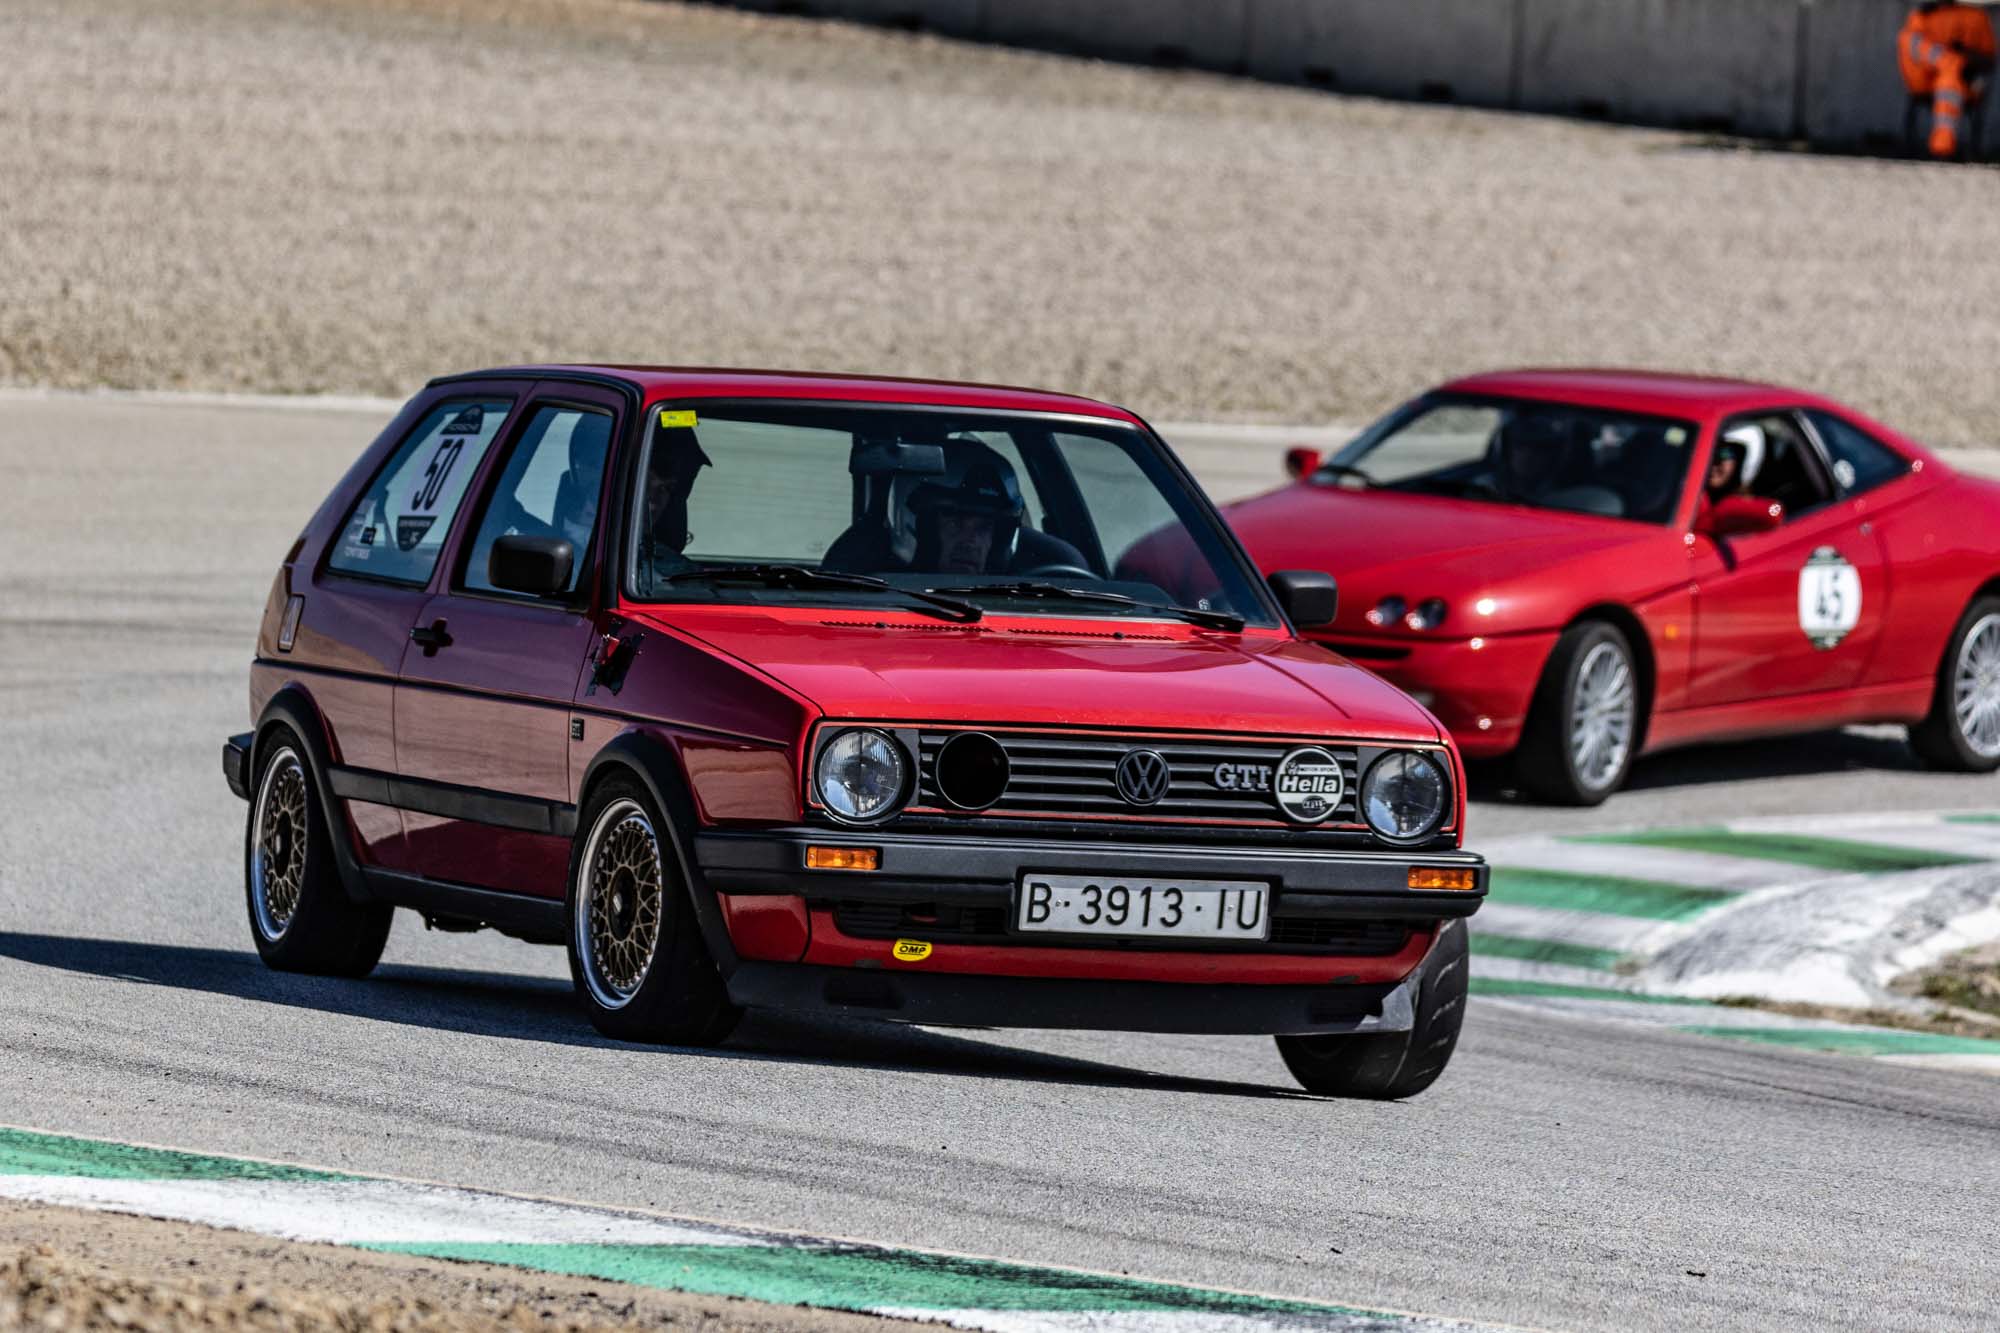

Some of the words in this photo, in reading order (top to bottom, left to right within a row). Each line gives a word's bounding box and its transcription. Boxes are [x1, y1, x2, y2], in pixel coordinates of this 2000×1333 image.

[411, 438, 465, 511] 50
[1214, 762, 1272, 792] GTI
[1280, 775, 1338, 793] Hella
[899, 944, 927, 954] OMP
